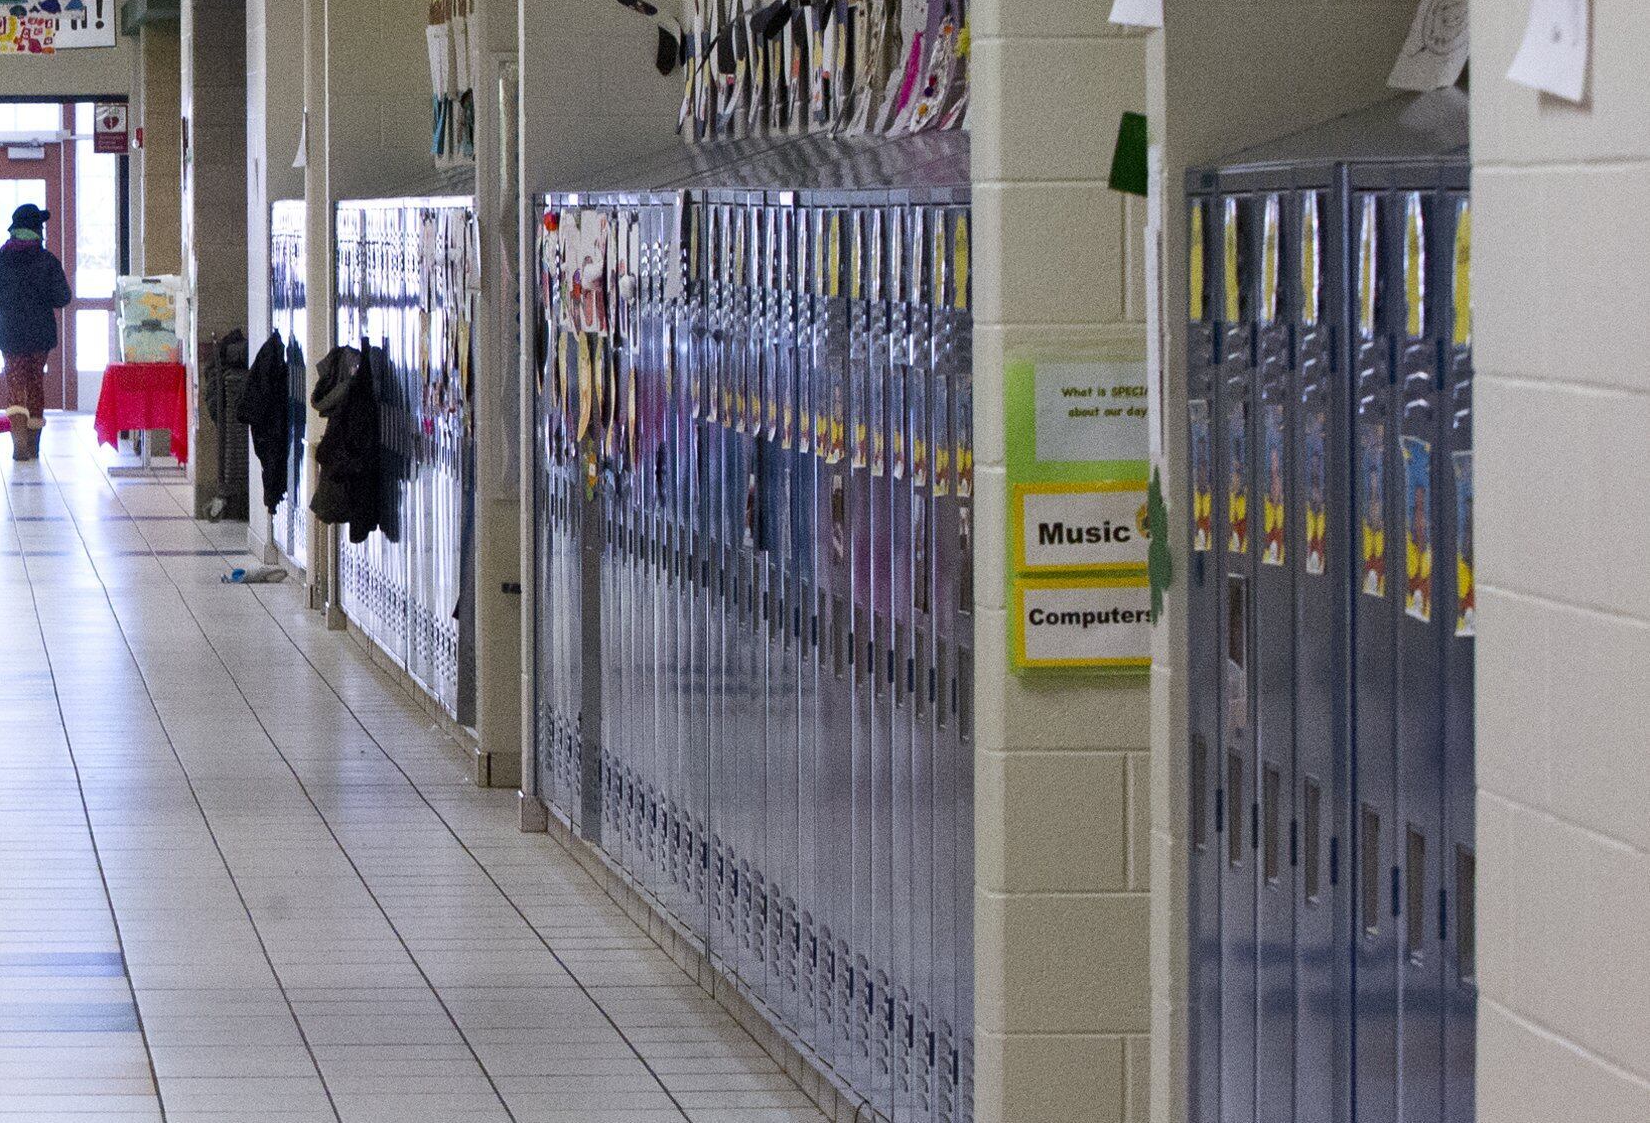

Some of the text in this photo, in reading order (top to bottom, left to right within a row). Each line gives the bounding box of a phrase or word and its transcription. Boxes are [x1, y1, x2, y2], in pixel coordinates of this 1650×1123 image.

[1061, 386, 1091, 397] What
[1098, 387, 1106, 397] is
[1068, 407, 1099, 417] about
[1104, 408, 1122, 417] our
[1039, 521, 1131, 545] Music
